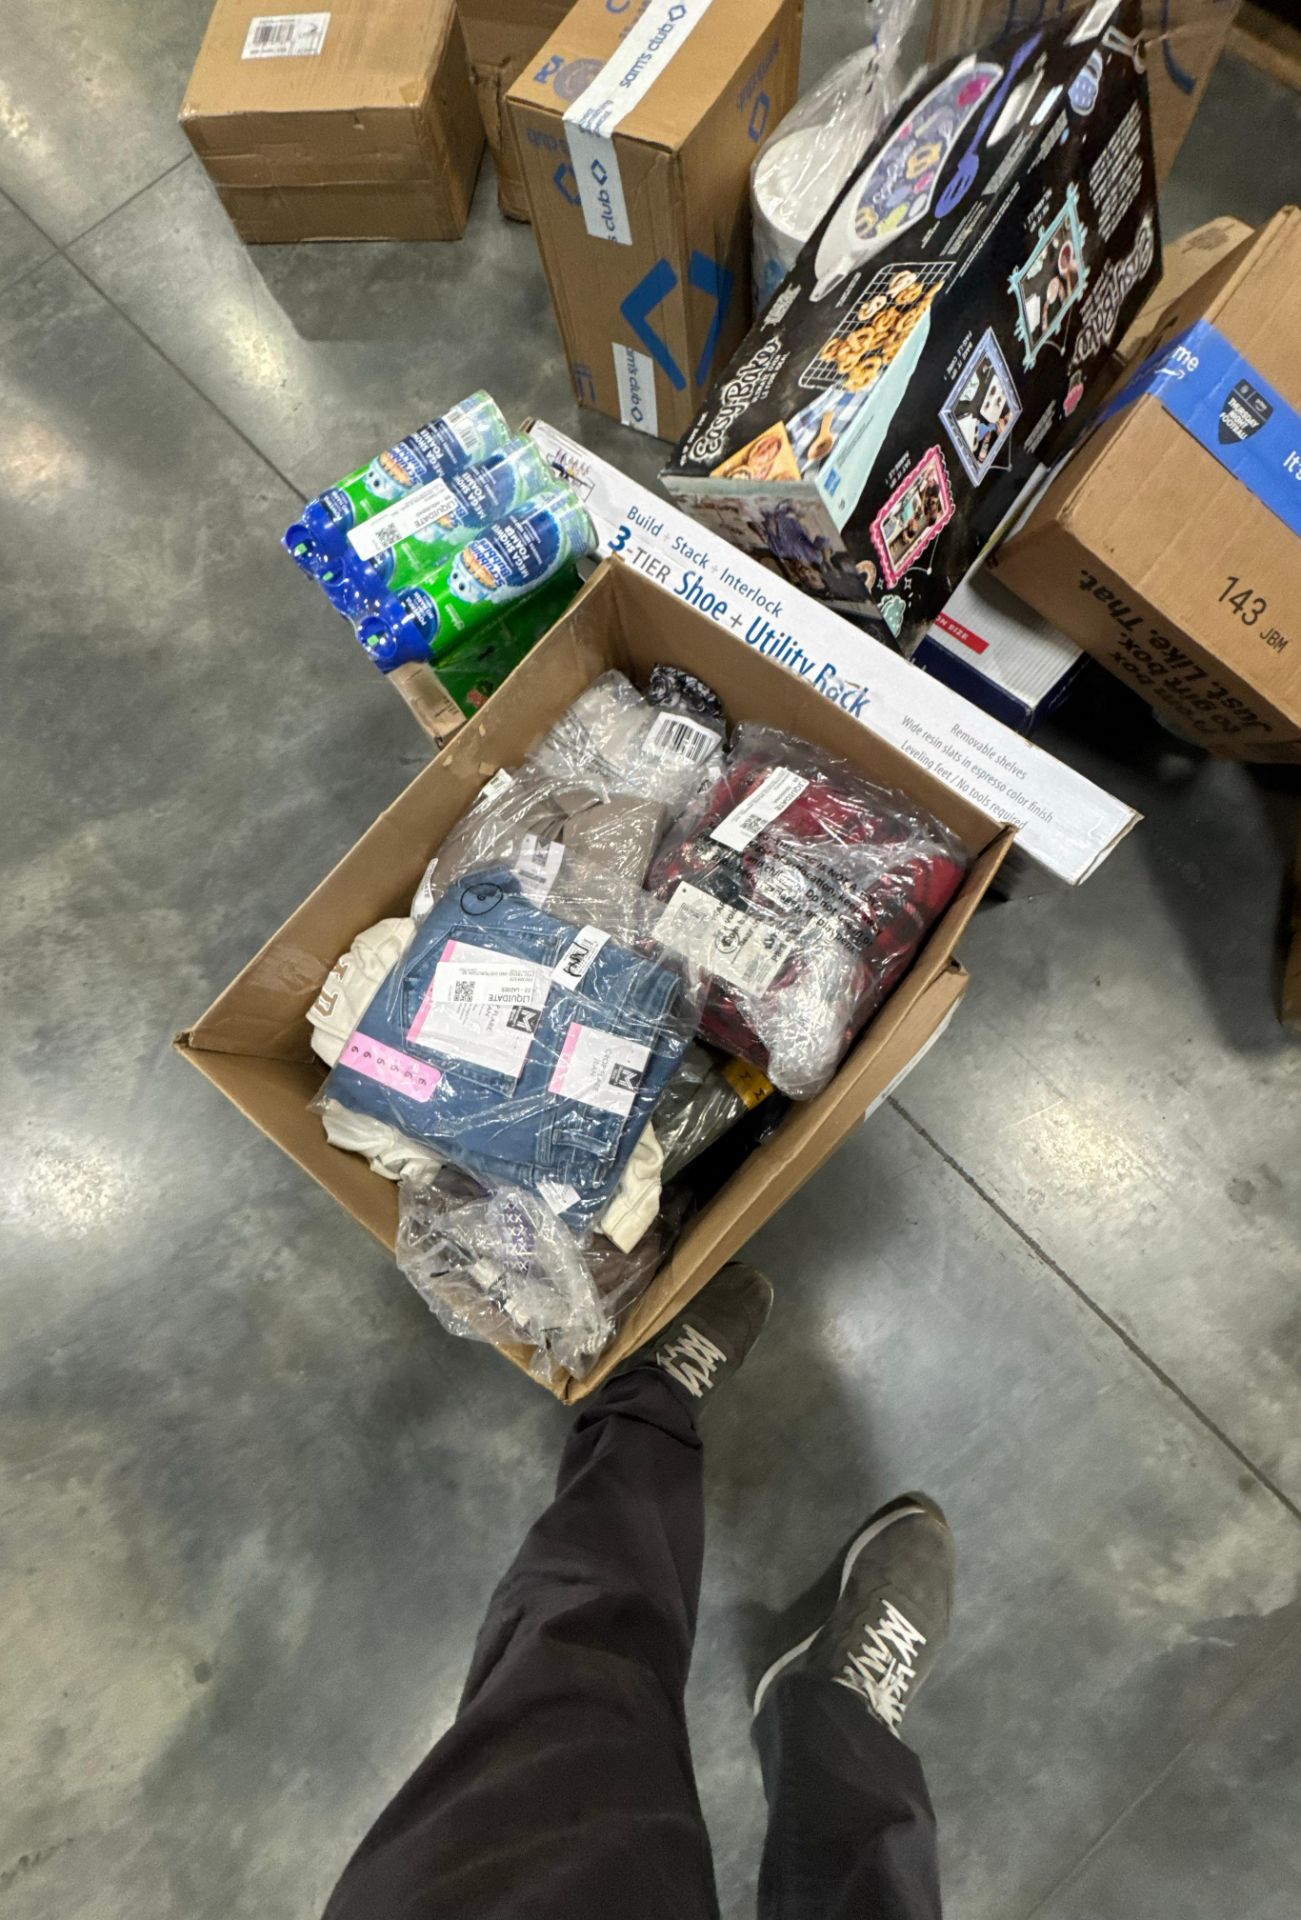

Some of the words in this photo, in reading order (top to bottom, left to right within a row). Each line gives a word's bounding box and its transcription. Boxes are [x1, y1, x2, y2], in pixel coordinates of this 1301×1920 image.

[619, 49, 651, 89] sam's
[647, 19, 674, 52] club
[597, 189, 615, 231] club
[629, 376, 640, 404] club
[1227, 397, 1259, 428] THURSDAY
[1227, 409, 1248, 429] NIGHT
[411, 430, 428, 451] SHOW
[386, 446, 420, 485] Scrubbi
[452, 473, 470, 493] SHOW
[413, 499, 455, 528] LIQUIDATE
[466, 492, 486, 518] MEGA
[477, 537, 510, 577] Bubbles
[504, 524, 530, 560] FOAMER
[510, 551, 529, 577] MEGA
[625, 504, 664, 537] Build
[670, 534, 711, 569] Stack
[718, 566, 785, 618] Interlock
[1076, 568, 1143, 632] That.
[1217, 574, 1269, 628] 143
[1258, 626, 1288, 653] JBM
[606, 523, 672, 584] 3-TIER
[672, 567, 734, 622] Shoe
[726, 611, 746, 631] +
[742, 614, 820, 681] Utility
[813, 660, 871, 717] Rack
[1145, 628, 1208, 683] Like.
[1205, 680, 1272, 730] Just.
[901, 714, 924, 736] Wide
[921, 729, 943, 750] resin
[940, 743, 962, 763] slats
[960, 756, 971, 768] in
[969, 764, 1007, 793] espresso
[1005, 786, 1028, 807] color
[1027, 800, 1053, 823] finish
[949, 722, 997, 759] Removable
[994, 751, 1027, 780] shelves
[774, 779, 807, 810] LIQUIDATE
[900, 739, 935, 769] Leveling
[933, 761, 953, 780] feet
[949, 773, 959, 785] /
[955, 777, 970, 792] No
[968, 785, 991, 807] tools
[988, 801, 1028, 830] required
[827, 868, 848, 886] NOT
[849, 882, 857, 890] A
[804, 888, 821, 902] Do
[818, 899, 838, 916] not
[488, 993, 529, 1002] LIQUIDATE
[618, 1069, 637, 1089] M
